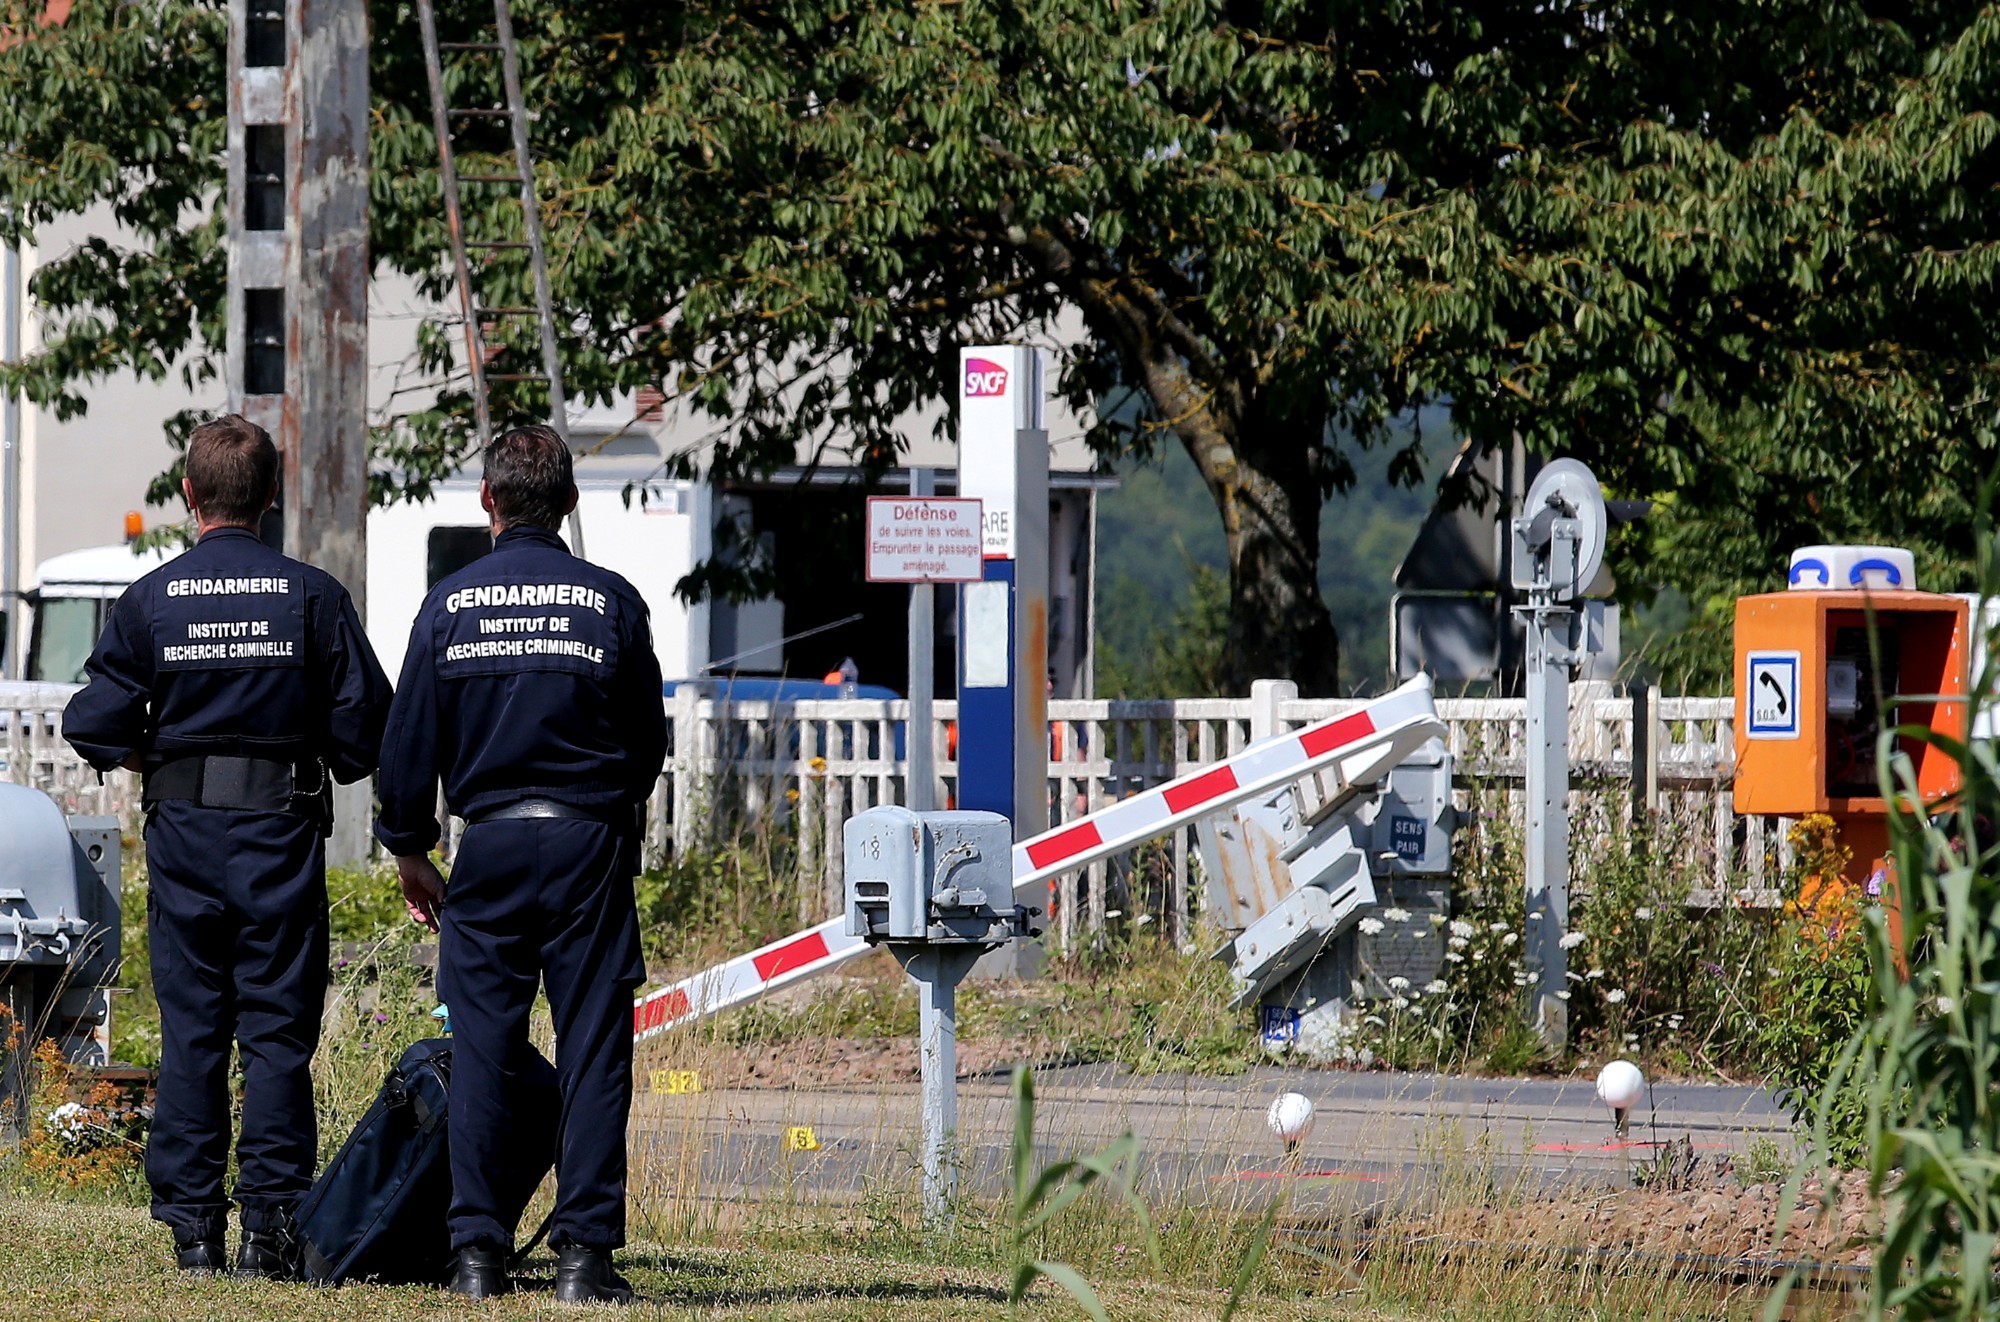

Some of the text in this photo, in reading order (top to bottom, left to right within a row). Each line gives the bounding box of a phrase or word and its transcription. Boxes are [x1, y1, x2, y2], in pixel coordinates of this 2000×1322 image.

[966, 371, 1005, 394] SNCF
[894, 504, 957, 520] Défense
[982, 511, 1008, 532] ARE
[879, 525, 973, 537] de suivre les voies.
[873, 542, 979, 557] Emprunter le passage
[903, 560, 949, 573] aménagé.
[166, 577, 289, 597] GENDARMERIE
[446, 584, 606, 615] GENDARMERIE
[187, 621, 269, 639] INSTITUT DE
[479, 617, 570, 634] INSTITUT DE
[163, 641, 293, 662] RECHERCHE CRIMINELLE
[446, 638, 604, 663] RECHERCHE CRIMINELLE
[1395, 821, 1423, 835] SENS
[860, 839, 880, 861] 18
[1397, 840, 1419, 854] PAIR
